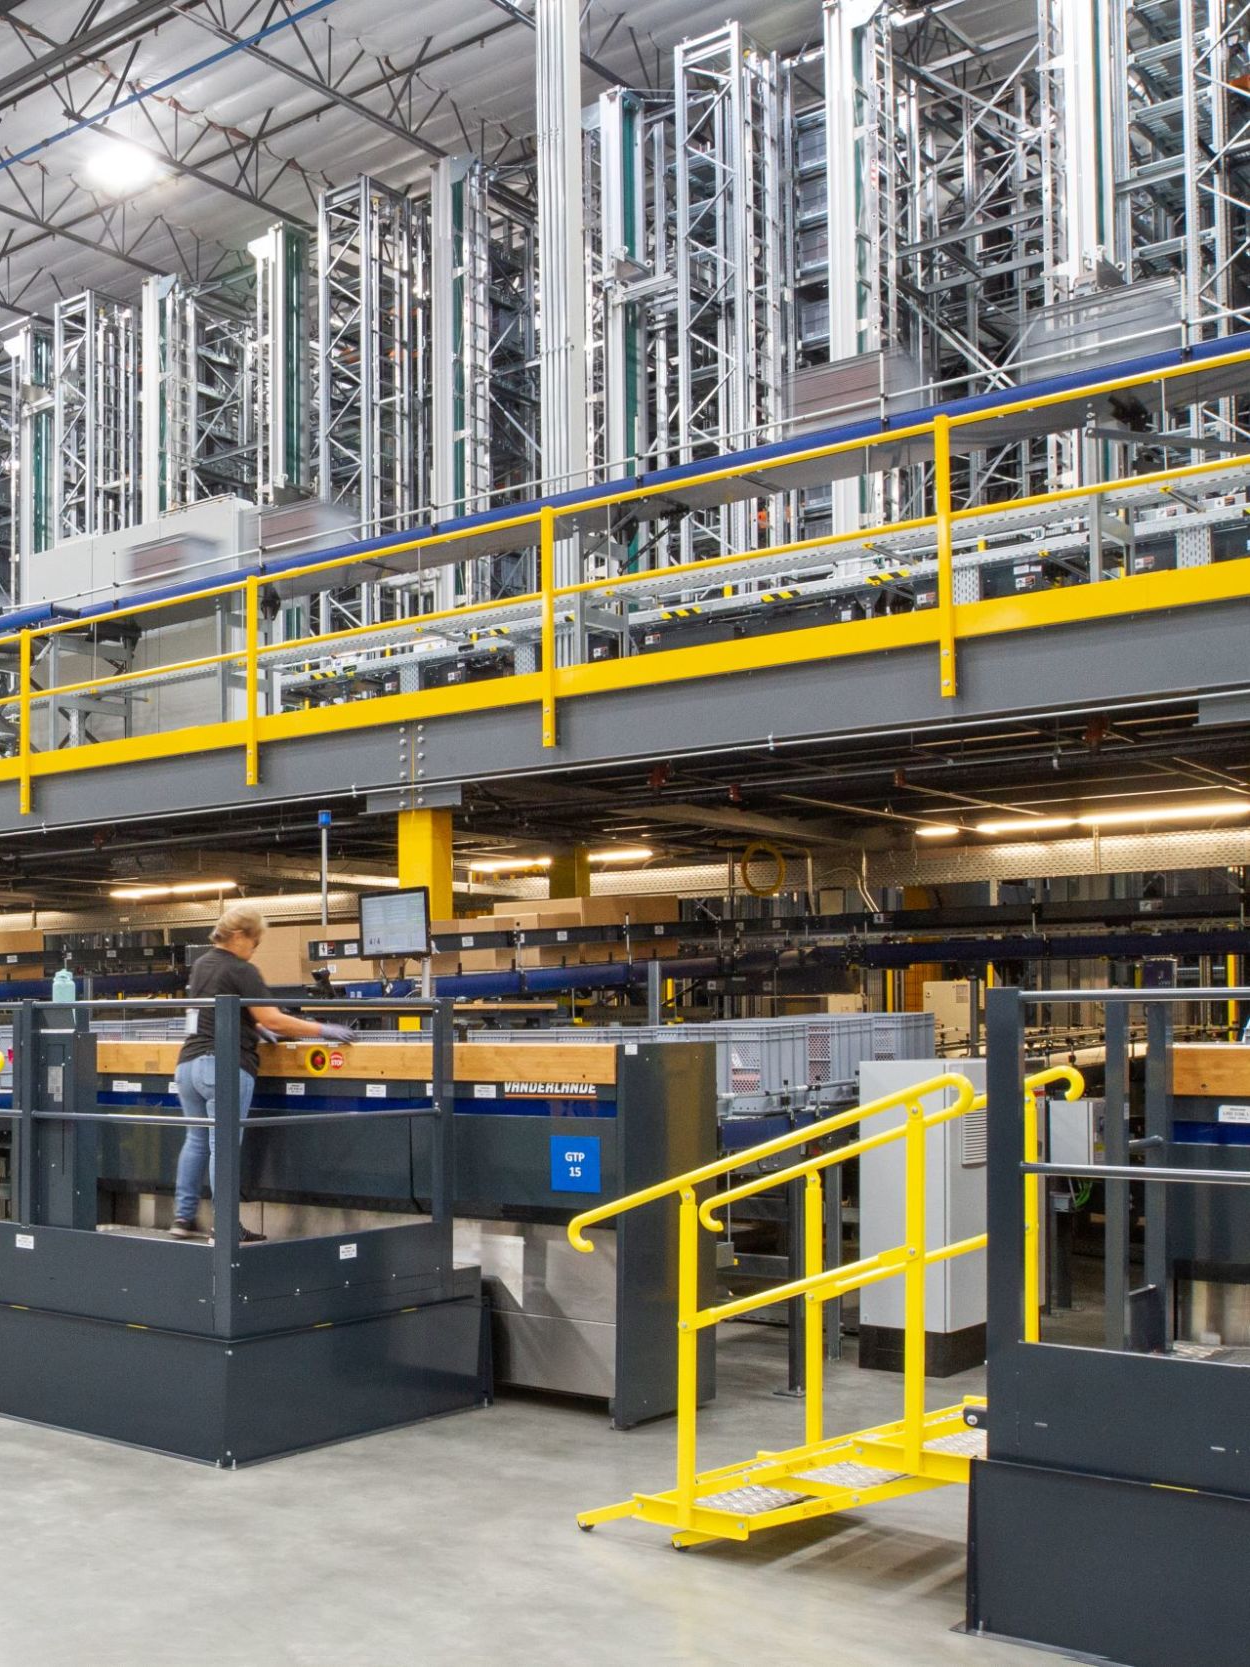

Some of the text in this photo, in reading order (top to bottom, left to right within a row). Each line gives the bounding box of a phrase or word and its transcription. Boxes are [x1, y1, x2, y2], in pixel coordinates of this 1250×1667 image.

[331, 1059, 343, 1067] STOP
[504, 1081, 596, 1094] VANDERLANDE
[565, 1152, 585, 1162] GTP
[569, 1166, 581, 1177] 15
